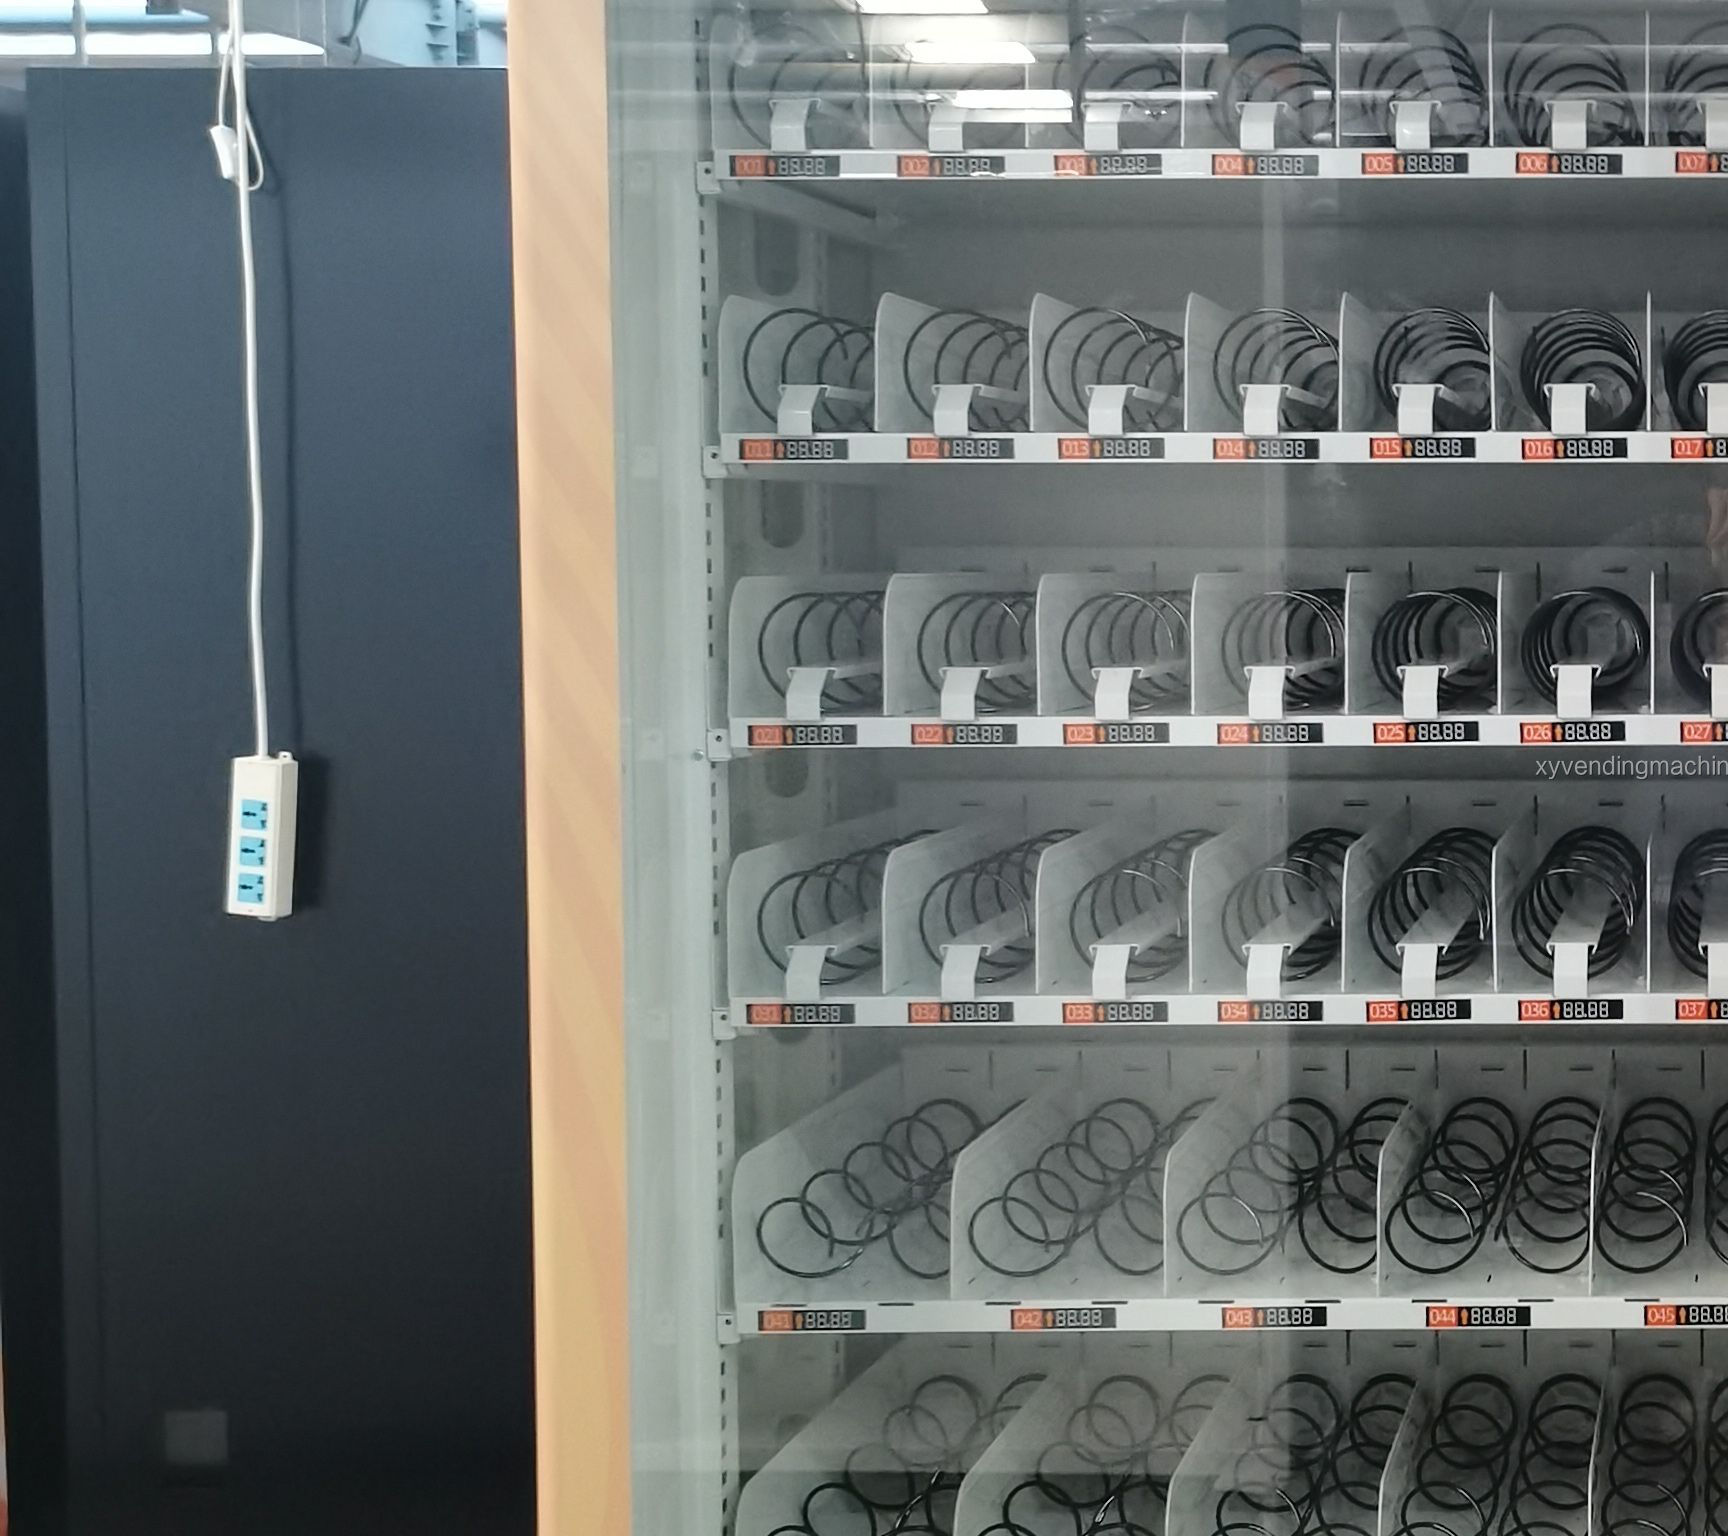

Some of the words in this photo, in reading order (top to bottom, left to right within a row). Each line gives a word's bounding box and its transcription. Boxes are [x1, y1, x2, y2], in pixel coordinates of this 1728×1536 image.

[1215, 157, 1243, 173] 004
[1365, 156, 1393, 172] 005
[1520, 156, 1547, 172] 006
[1679, 155, 1707, 171] 007
[911, 440, 938, 456] 012
[1061, 441, 1089, 457] 013
[1215, 441, 1244, 457] 014
[1373, 440, 1401, 456] 015
[1525, 441, 1553, 457] 016
[1673, 441, 1702, 456] 017
[915, 727, 942, 743] 022
[1067, 726, 1095, 742] 023
[1221, 726, 1248, 741] 024
[1377, 725, 1404, 741] 025
[1523, 725, 1551, 741] 026
[1684, 724, 1712, 740] 027
[911, 1004, 939, 1020] 032
[1066, 1004, 1093, 1020] 033
[1221, 1003, 1248, 1019] 034
[1369, 1003, 1397, 1019] 035
[1521, 1003, 1549, 1018] 036
[1678, 1002, 1706, 1017] 037
[1015, 1311, 1042, 1327] 042
[1225, 1309, 1253, 1325] 043
[1428, 1308, 1457, 1325] 044
[1648, 1307, 1675, 1323] 045
